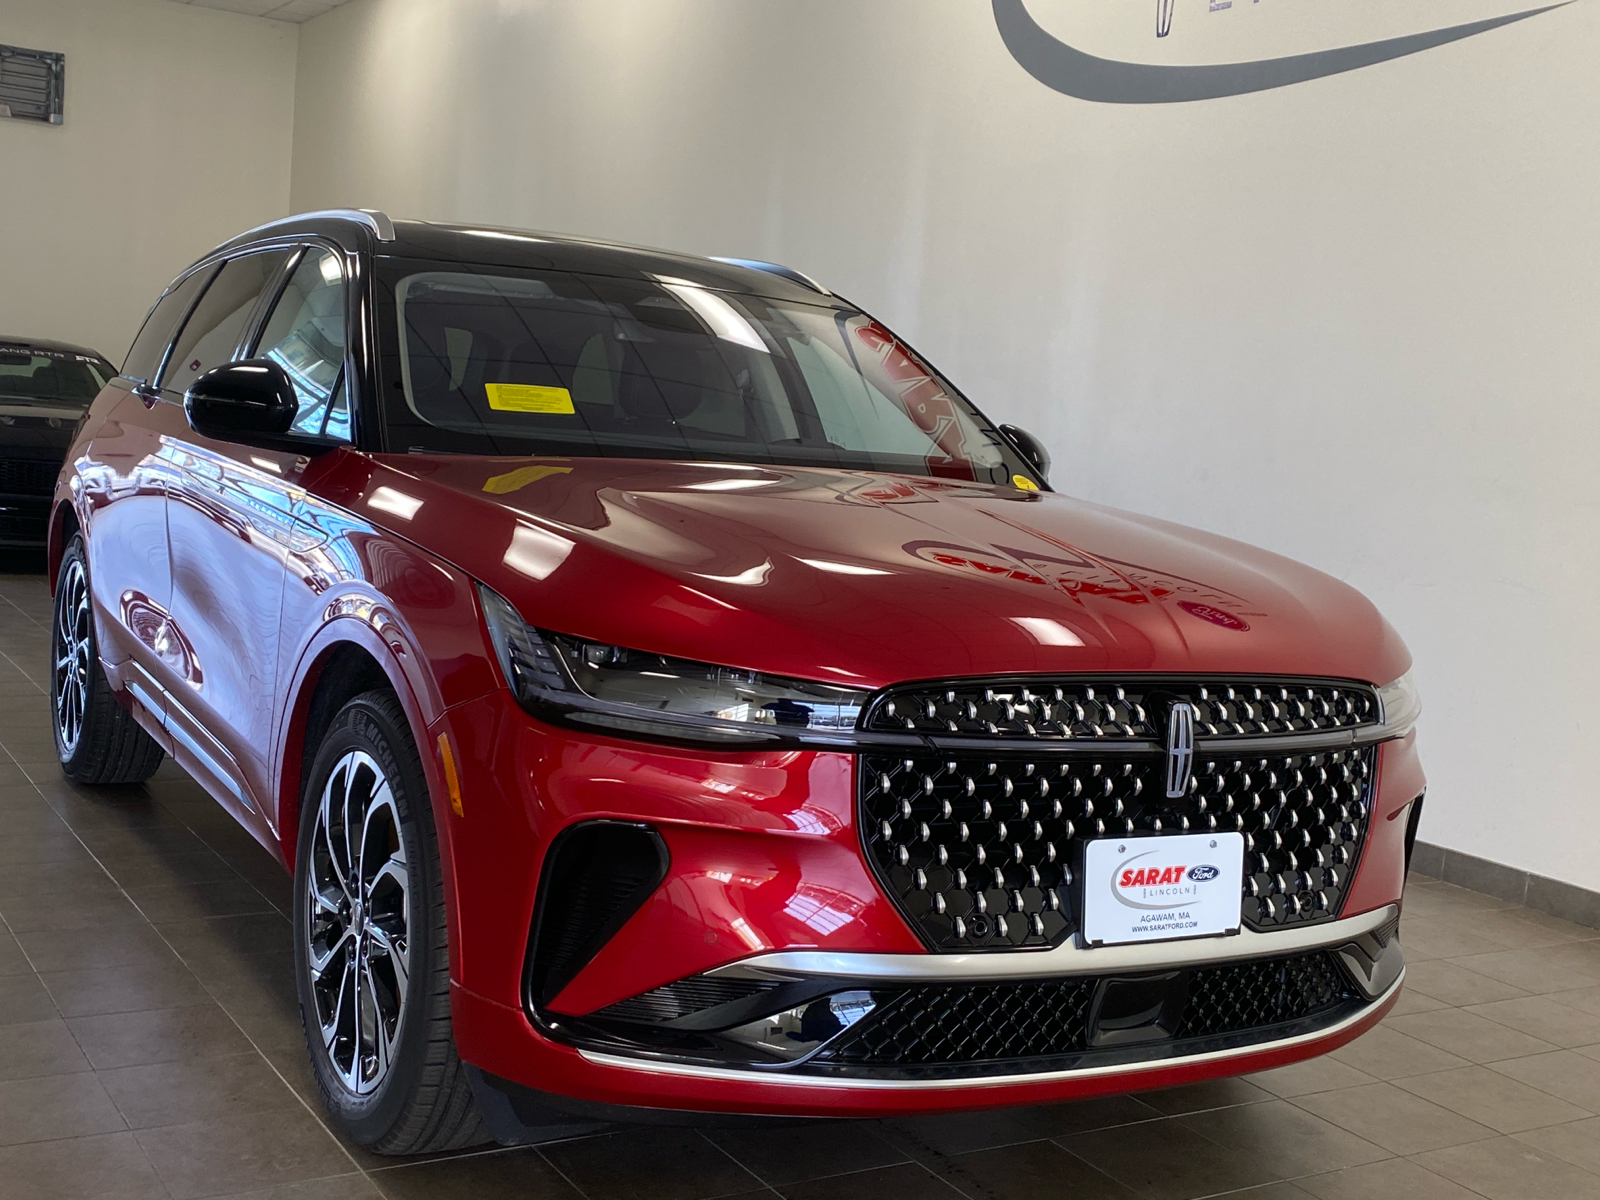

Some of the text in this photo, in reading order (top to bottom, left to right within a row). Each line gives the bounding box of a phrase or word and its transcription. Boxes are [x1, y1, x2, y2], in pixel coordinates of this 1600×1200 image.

[365, 722, 409, 818] MICHELIN
[1119, 866, 1186, 887] SARAT
[1150, 887, 1190, 896] LINCOLN
[1140, 911, 1190, 922] AGAWAM, MA
[1132, 921, 1198, 932] WWW.SARATFORD.COM
